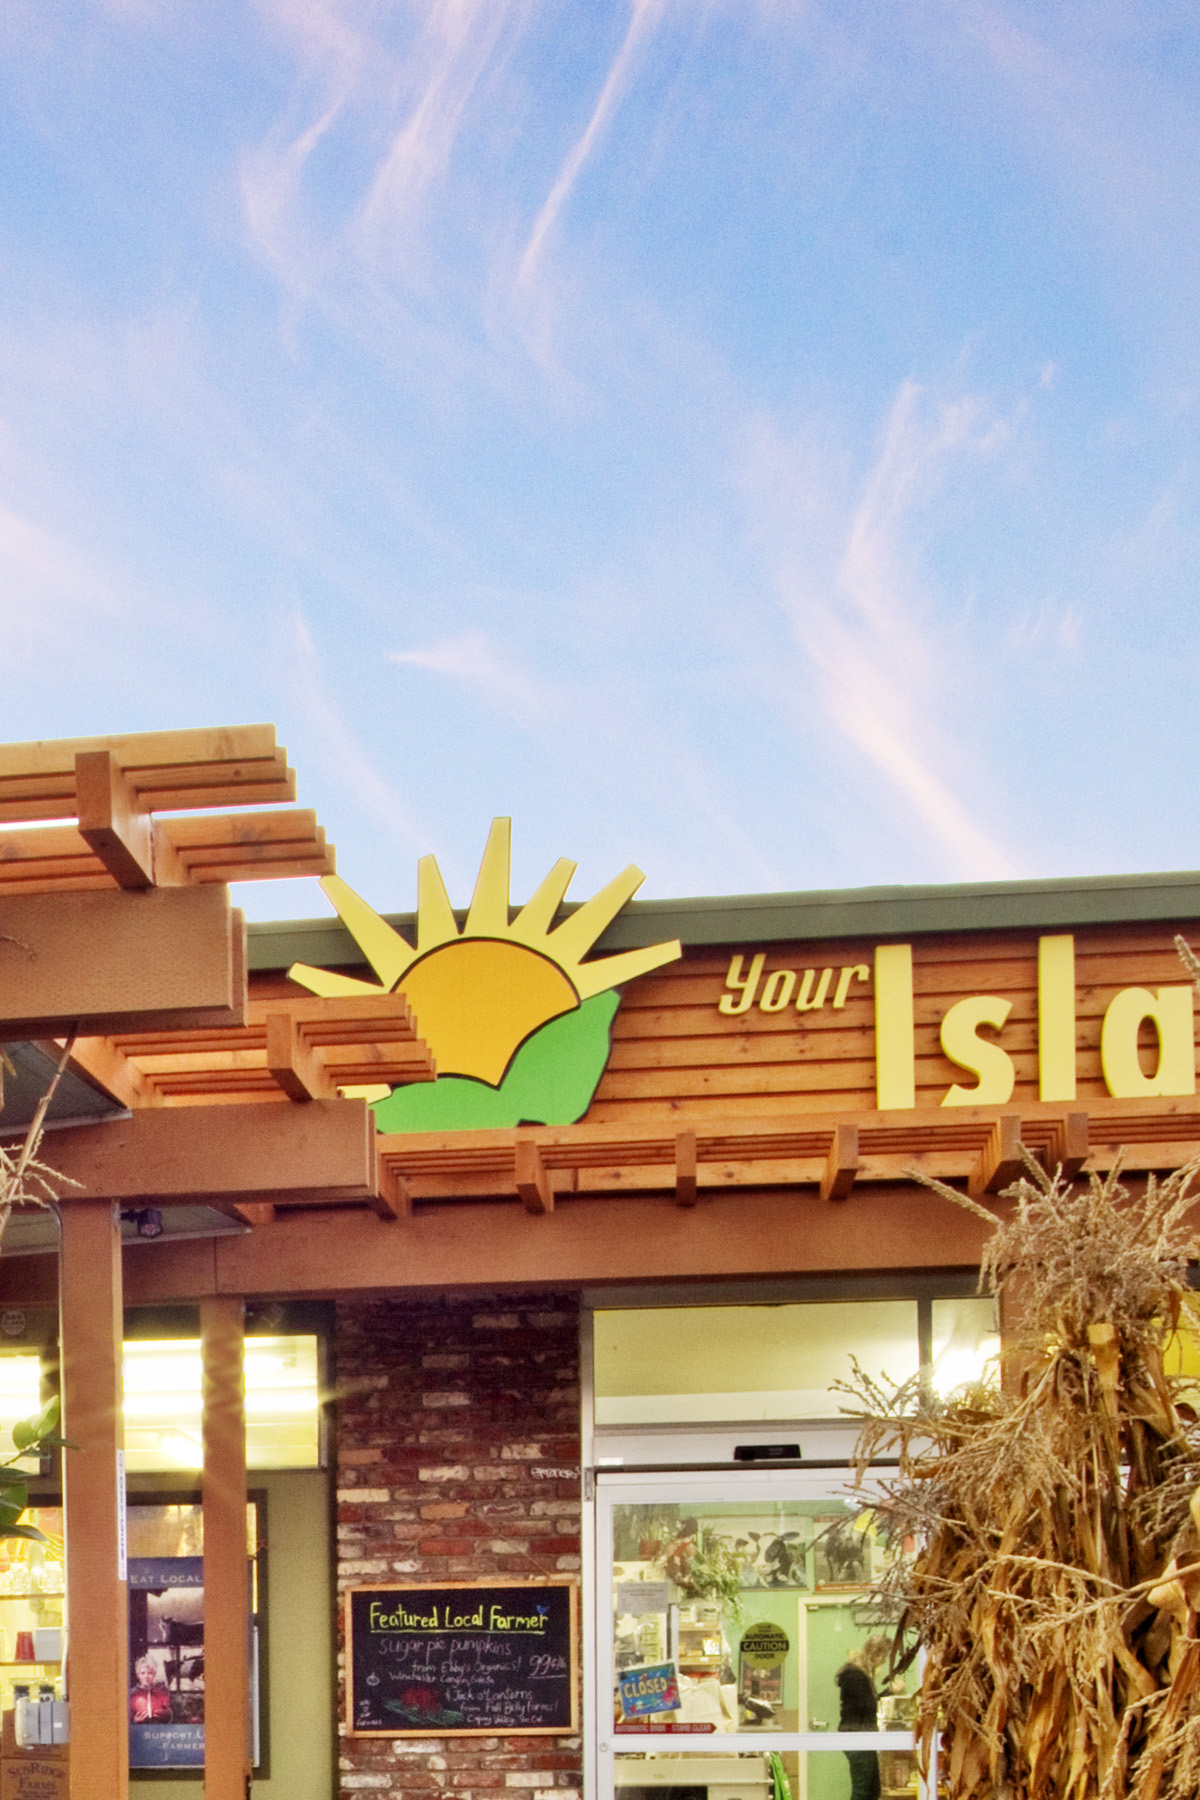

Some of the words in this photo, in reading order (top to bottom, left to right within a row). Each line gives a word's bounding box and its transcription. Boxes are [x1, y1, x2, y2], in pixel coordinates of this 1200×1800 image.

[718, 953, 870, 1016] Your
[874, 935, 1196, 1111] Isla
[130, 1575, 154, 1584] EAT
[160, 1574, 203, 1584] LOCAL
[369, 1602, 438, 1629] Featured
[445, 1605, 484, 1628] Local
[489, 1605, 548, 1630] Farmer
[745, 1632, 784, 1640] AUTOMATIC
[425, 1637, 446, 1664] pie
[449, 1635, 511, 1663] pumpkins
[743, 1641, 787, 1651] CAUTION
[623, 1677, 668, 1699] CLOSED
[615, 1724, 649, 1732] AUTOMATIC
[650, 1724, 666, 1732] DOOR
[671, 1724, 691, 1732] STAND
[692, 1724, 712, 1732] CLEAR
[144, 1731, 193, 1740] SUPPORT
